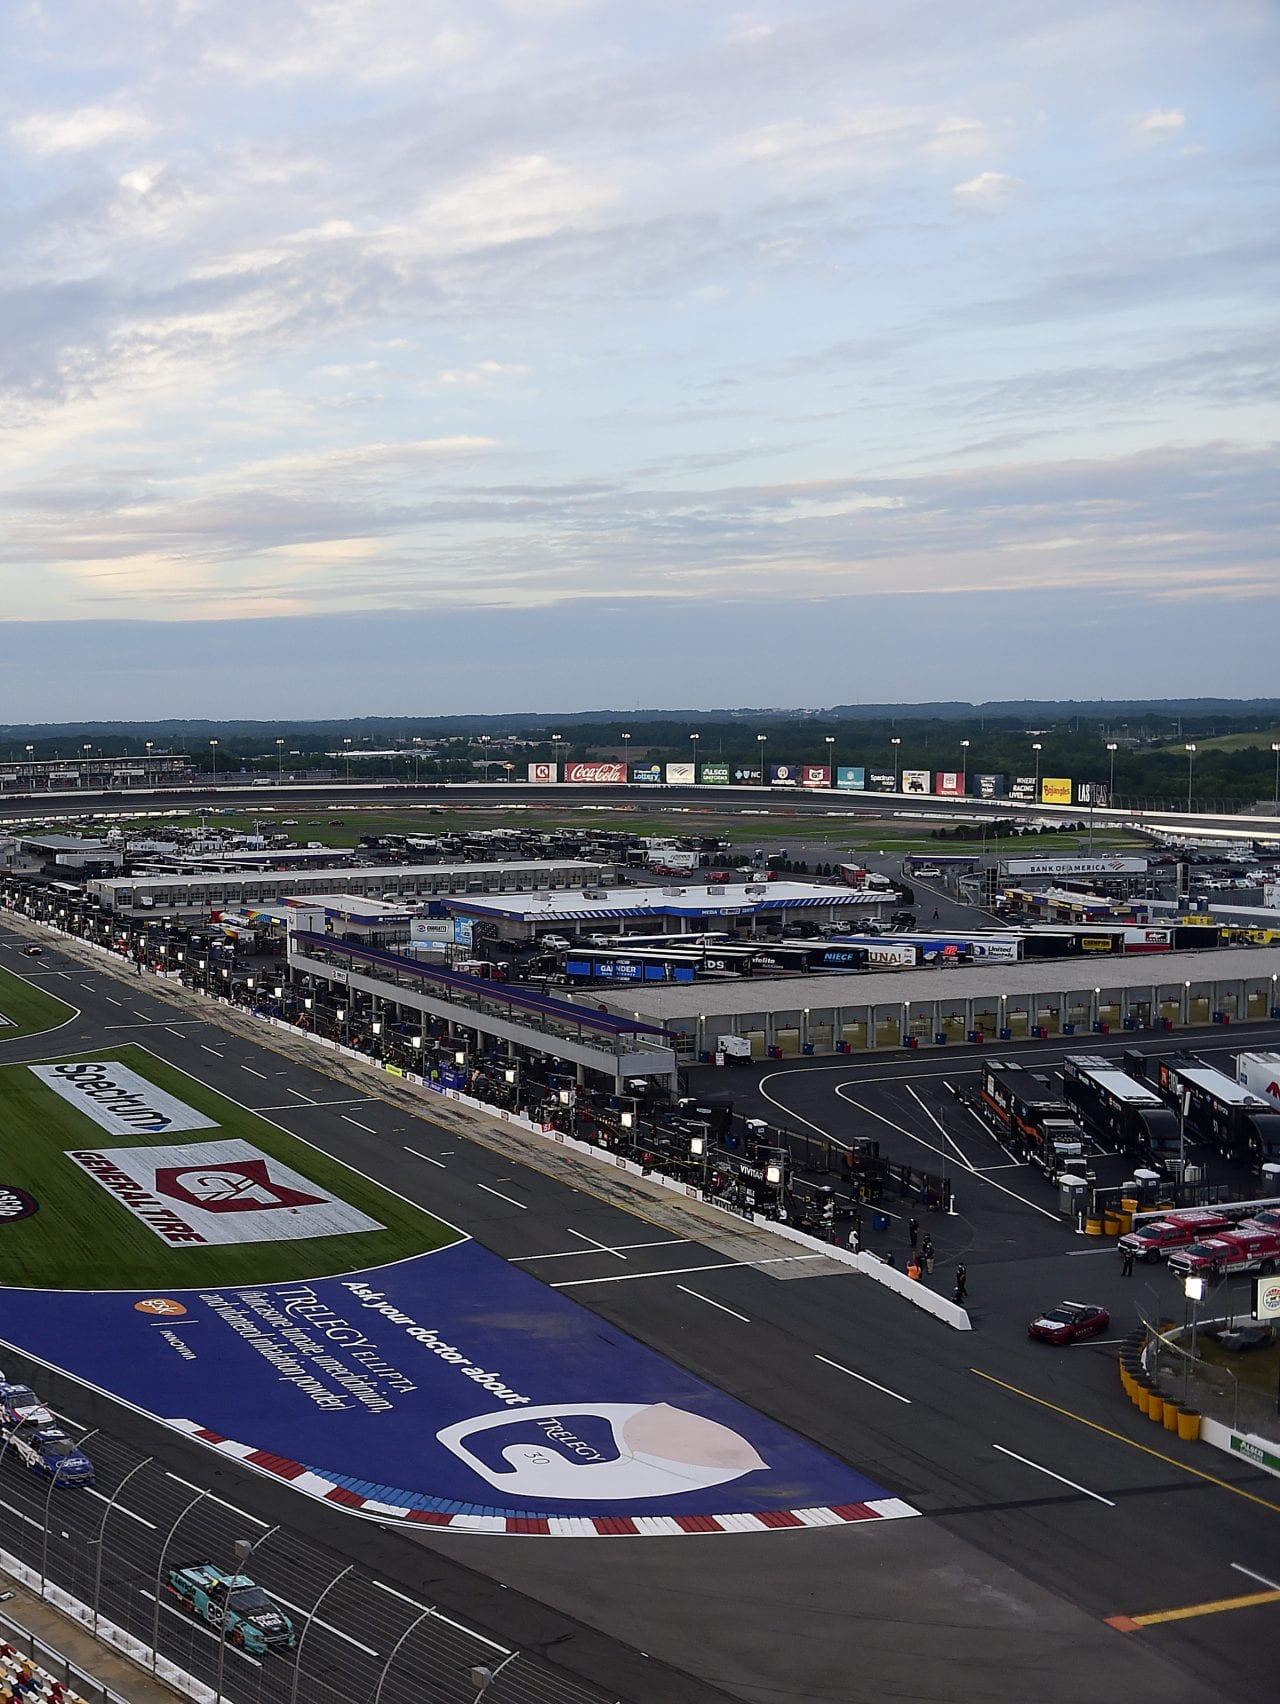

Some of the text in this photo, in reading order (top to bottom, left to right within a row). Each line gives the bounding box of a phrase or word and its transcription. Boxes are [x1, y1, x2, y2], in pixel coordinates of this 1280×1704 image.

[571, 764, 624, 782] Coca-Cola
[633, 773, 659, 781] Lottery
[703, 768, 728, 776] ALSCO
[870, 774, 895, 783] Spectrum
[1078, 783, 1090, 802] LAS
[988, 945, 1012, 953] United
[1083, 939, 1111, 947] CHAMPION
[824, 952, 853, 961] NIECE
[53, 1062, 170, 1132] Spectrum
[71, 1152, 208, 1243] GENERAL TIRE
[141, 1298, 178, 1316] gsk
[159, 1330, 197, 1361] INNOVIVA
[275, 1286, 418, 1394] TRELEGY ELLIPTA
[341, 1282, 531, 1406] Ask your doctor about
[199, 1293, 357, 1411] and vilanterol inhalation powder)
[535, 1417, 606, 1462] TRELEGY
[522, 1451, 552, 1466] 30
